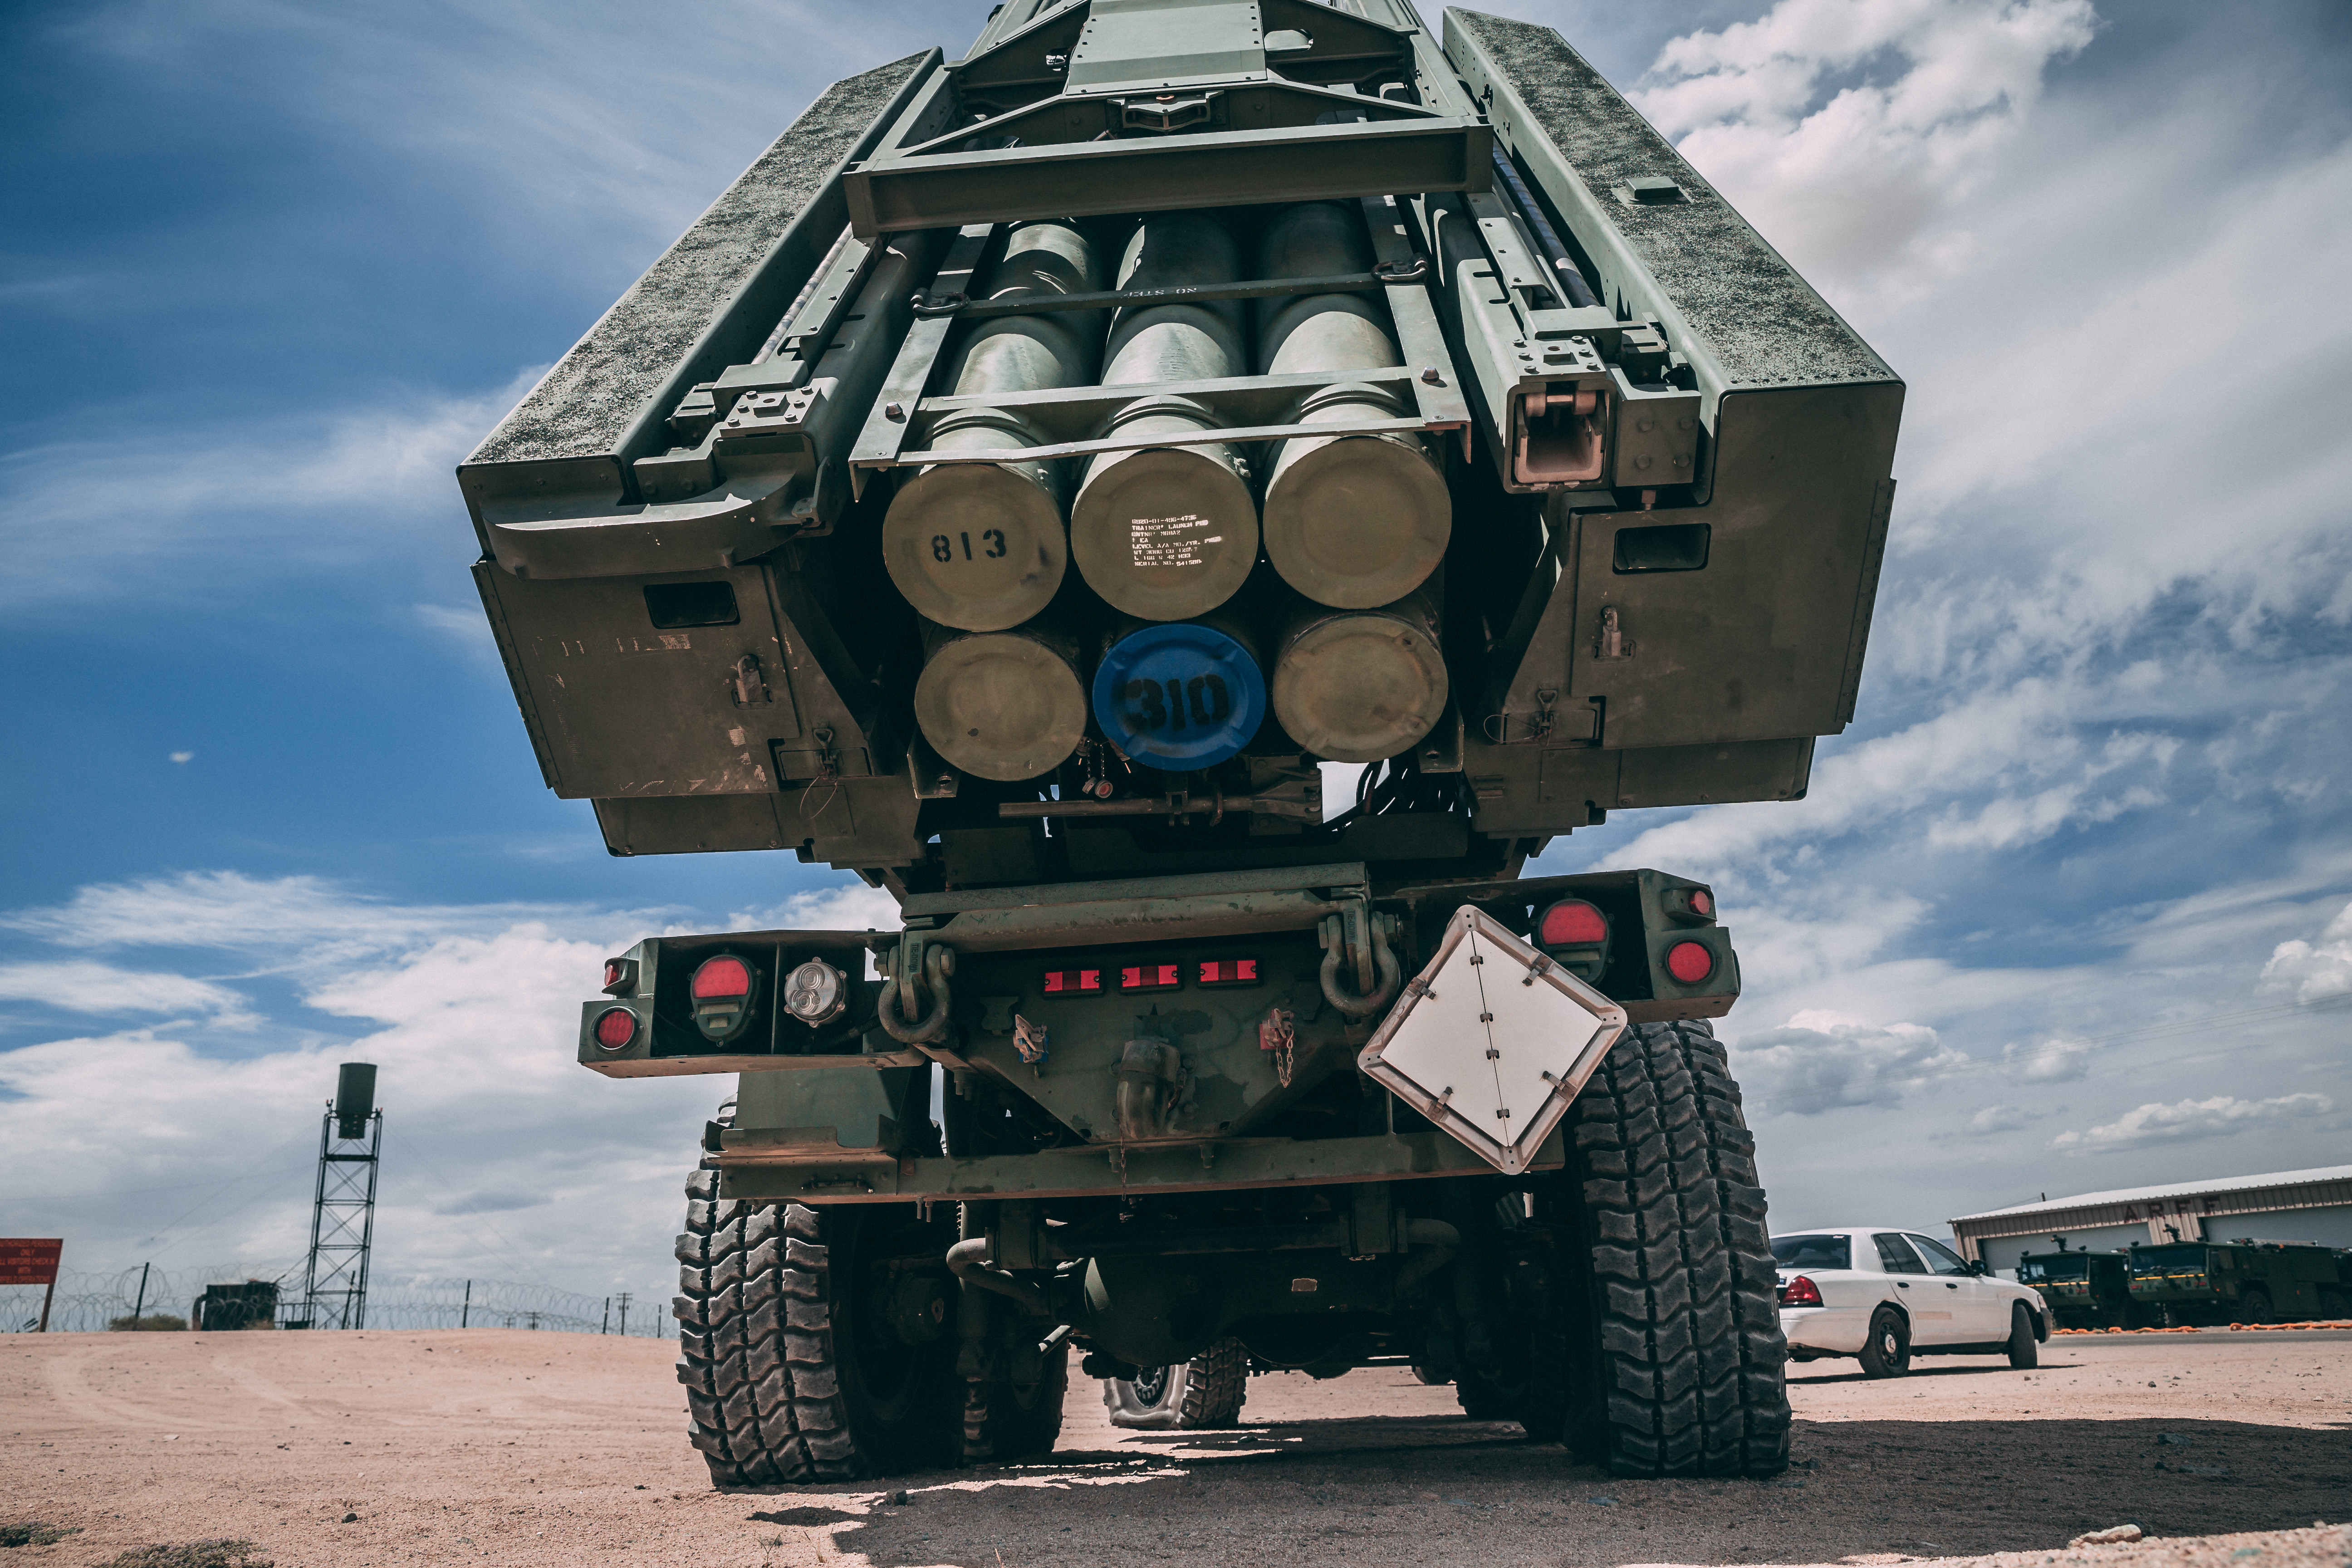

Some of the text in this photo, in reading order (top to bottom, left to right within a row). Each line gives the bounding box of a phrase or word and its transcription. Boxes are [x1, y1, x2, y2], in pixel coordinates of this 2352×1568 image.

[931, 529, 1007, 563] 813
[1122, 674, 1229, 731] 310
[1348, 910, 1356, 940] TIE-DOWN
[910, 943, 919, 973] TIE-DOWN
[2124, 1196, 2220, 1224] ARFF
